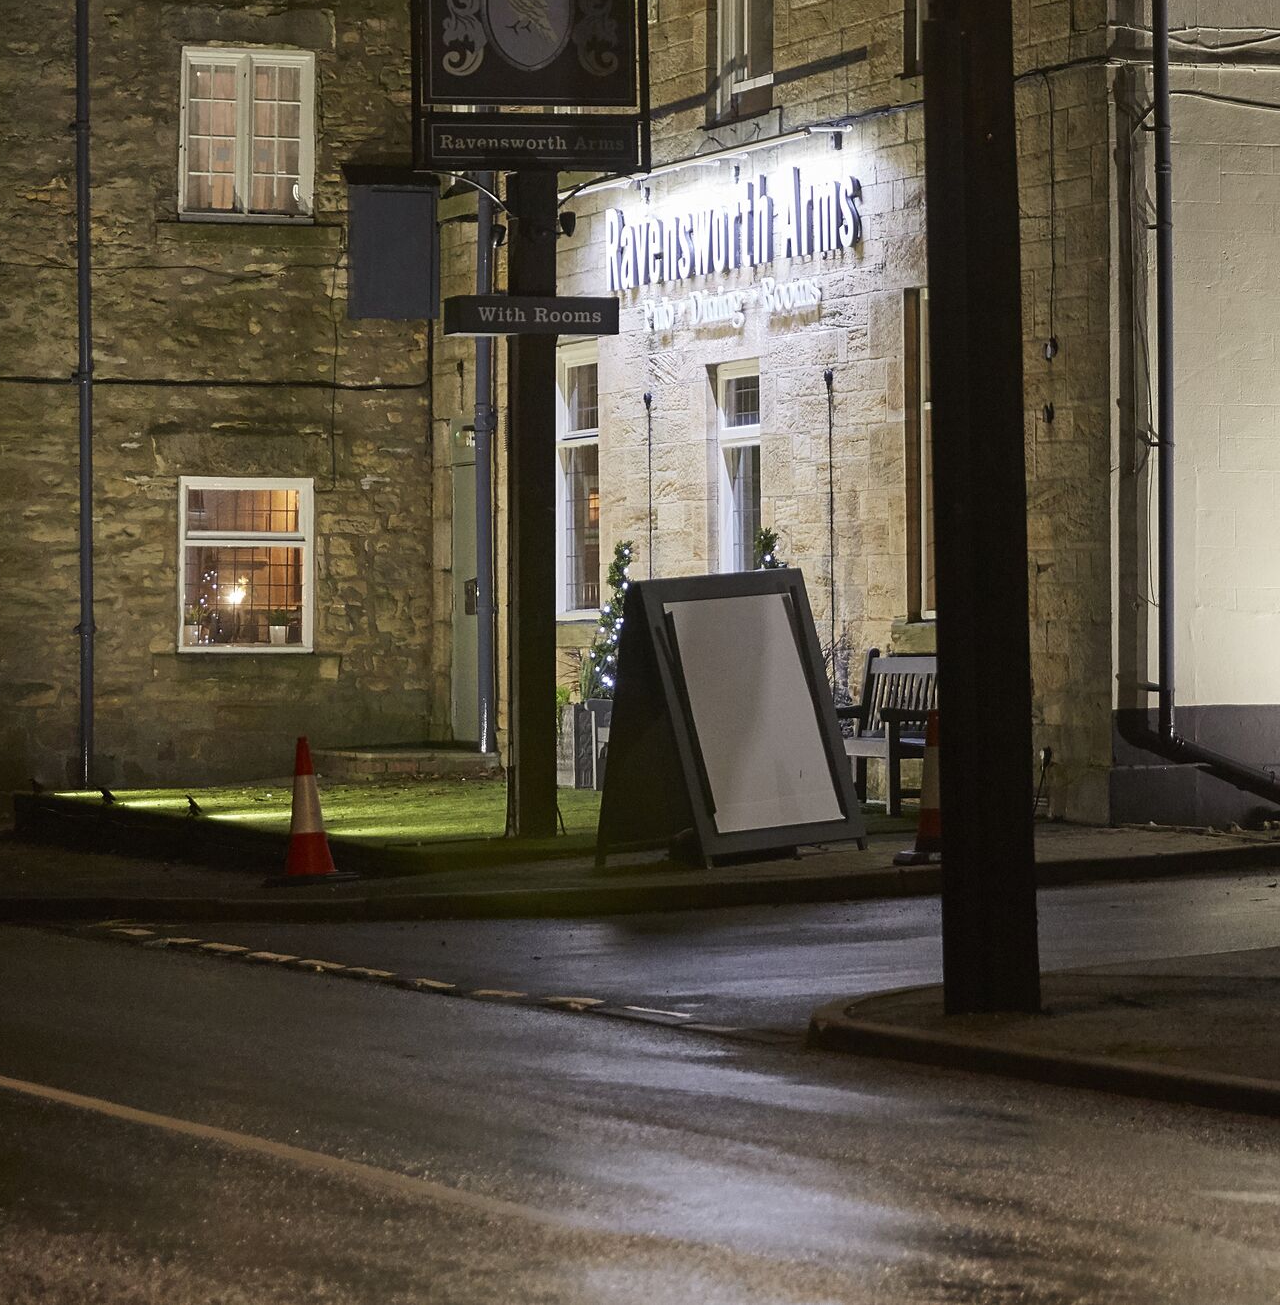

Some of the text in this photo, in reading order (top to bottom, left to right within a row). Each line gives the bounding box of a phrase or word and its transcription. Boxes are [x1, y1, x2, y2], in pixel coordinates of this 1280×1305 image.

[439, 134, 625, 152] Ravensworth Arms
[605, 166, 862, 292] Ravensworth Arms
[477, 306, 602, 323] With Rooms
[644, 276, 822, 332] Pub Dining Rooms
